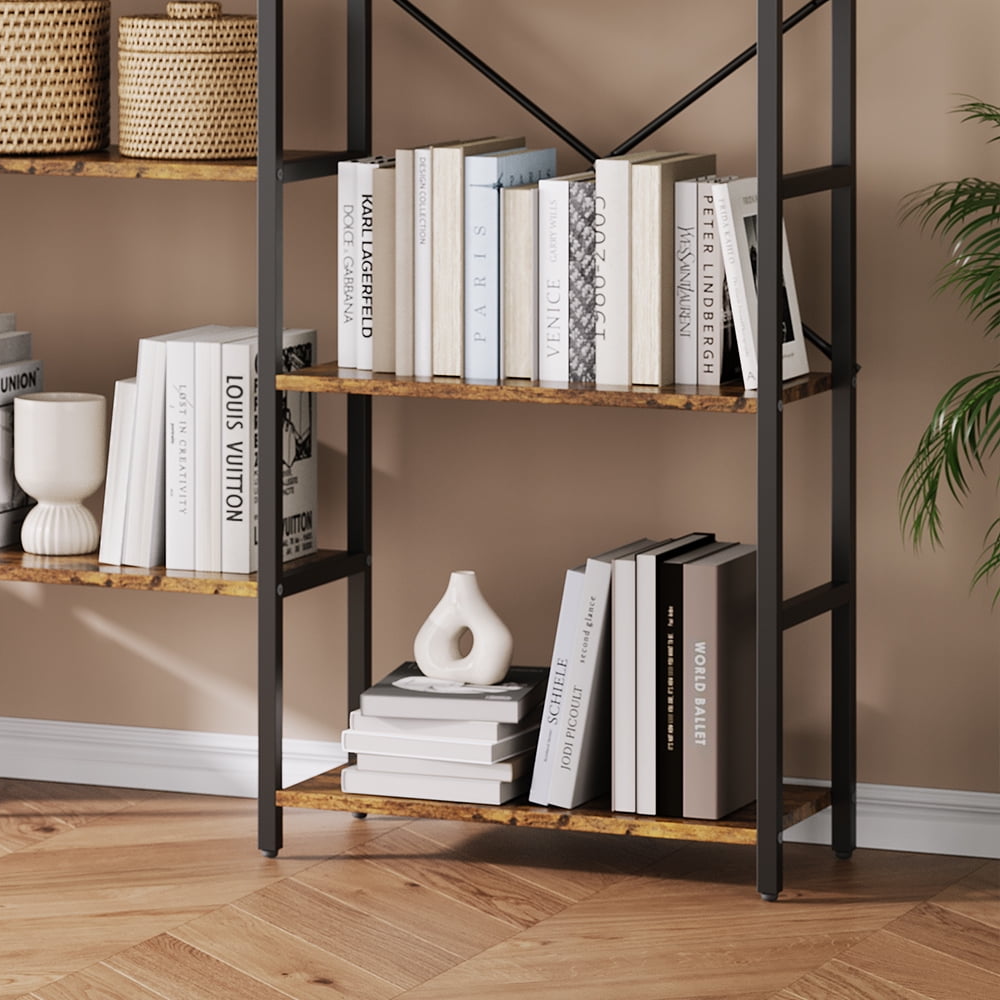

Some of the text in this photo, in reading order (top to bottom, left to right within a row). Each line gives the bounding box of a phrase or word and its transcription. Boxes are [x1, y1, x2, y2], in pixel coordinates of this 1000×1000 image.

[343, 204, 354, 247] DOLCE
[343, 256, 354, 324] GABBANA
[361, 194, 373, 338] KARL LAGERFELD
[474, 225, 487, 342] PARIS
[703, 195, 714, 374] PETER LINDBERGH
[547, 279, 561, 358] VENICE
[1, 370, 36, 392] UNION
[179, 421, 187, 433] IN
[226, 375, 244, 522] LOUIS VUITTON
[179, 439, 187, 515] CREATIVITY
[580, 596, 596, 664] second glance
[548, 658, 568, 725] SCHIELE
[560, 685, 583, 771] JODI PICOULT
[694, 641, 706, 746] WORLD BALLET
